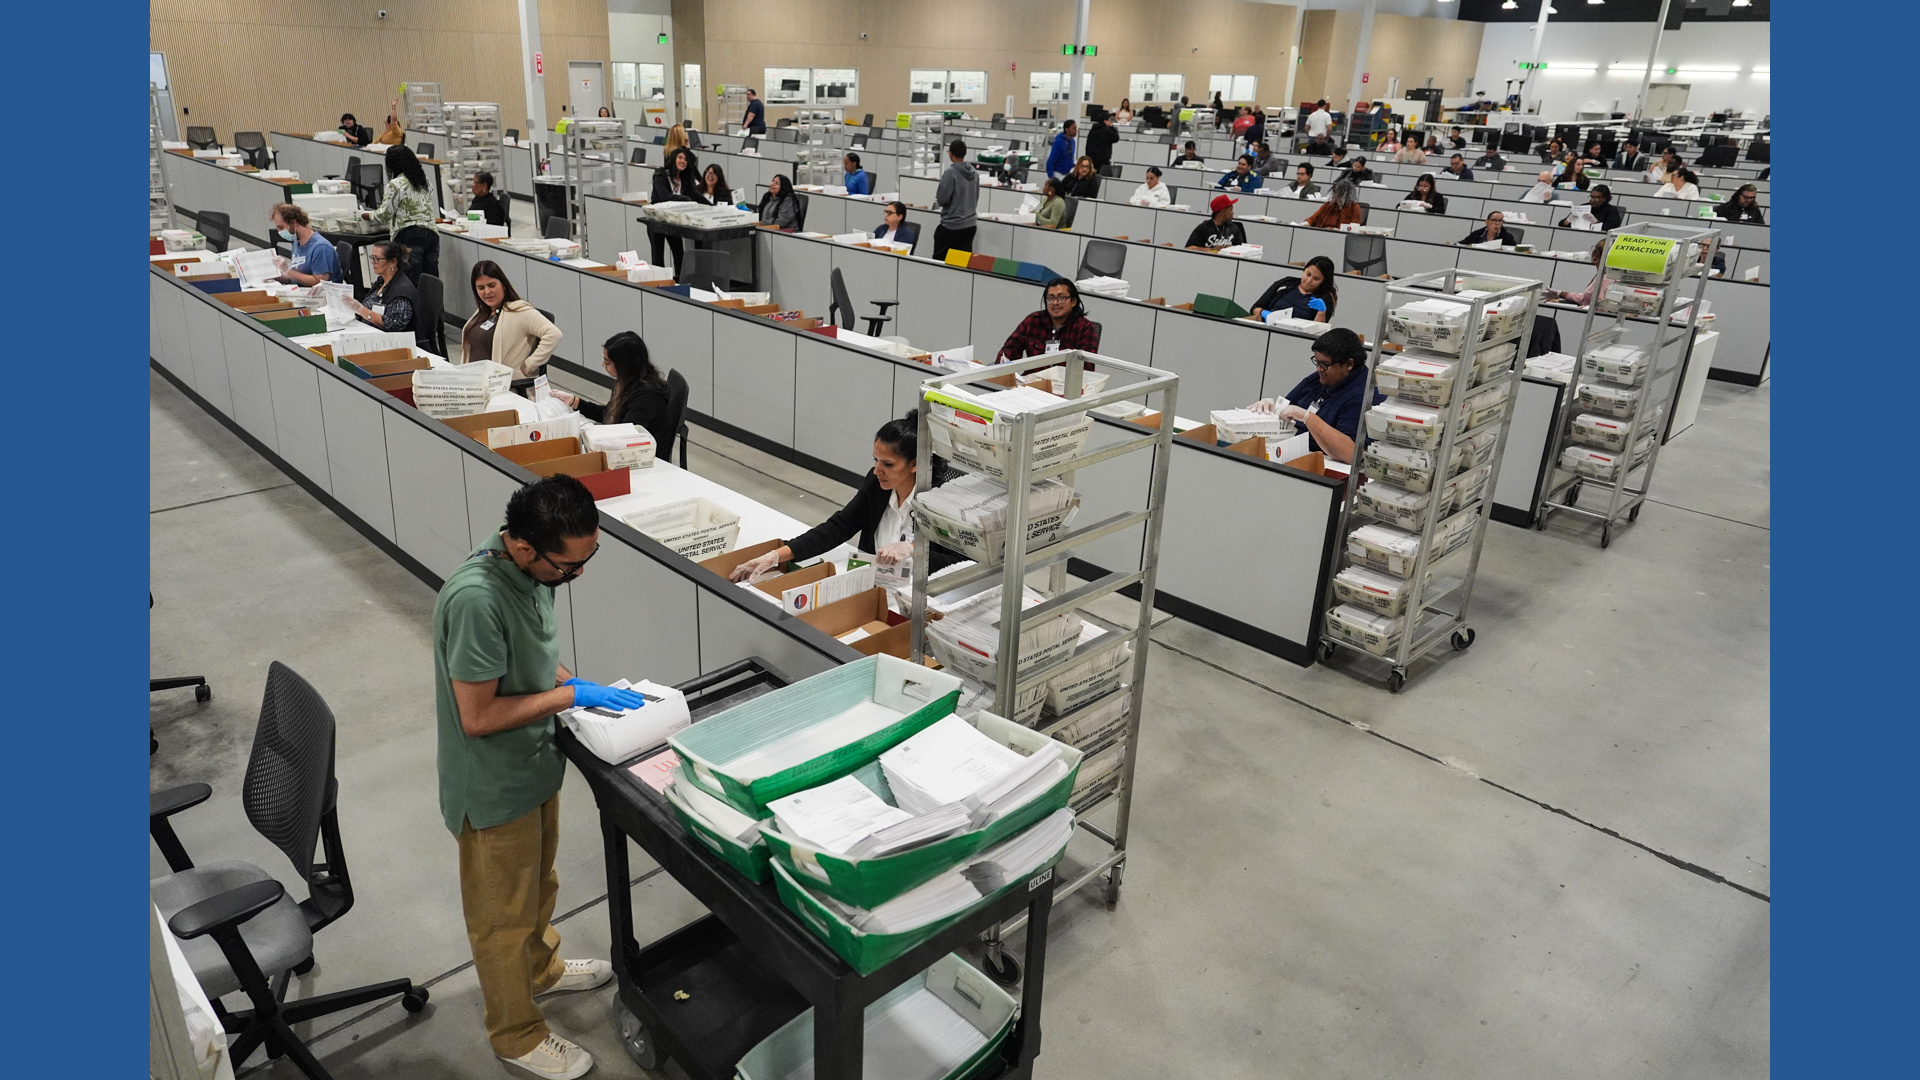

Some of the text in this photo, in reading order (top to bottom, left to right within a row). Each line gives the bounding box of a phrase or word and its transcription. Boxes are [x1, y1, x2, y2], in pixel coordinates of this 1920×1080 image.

[1623, 236, 1649, 244] READY
[1615, 244, 1666, 256] EXTRACTION
[1033, 426, 1089, 446] TATES POSTAL SERVICE
[1034, 515, 1060, 529] STATES
[663, 521, 736, 544] UNITED STATES POSTAL SERVICE
[958, 529, 976, 537] LABEL
[960, 535, 979, 543] OTHER
[1031, 522, 1062, 540] SERVICE
[678, 536, 725, 554] UNITED STATES
[683, 543, 727, 559] OSTAL SERVICE
[1023, 651, 1043, 664] STATES
[1043, 643, 1061, 655] POSTAL
[1061, 633, 1080, 646] SERVICE
[1060, 656, 1130, 693] UNITED STATES POSTAL SERVICE
[1014, 707, 1027, 717] STAL
[792, 706, 935, 777] UNITED STATES POSTAL SERVICE
[1030, 871, 1051, 888] ULINE
